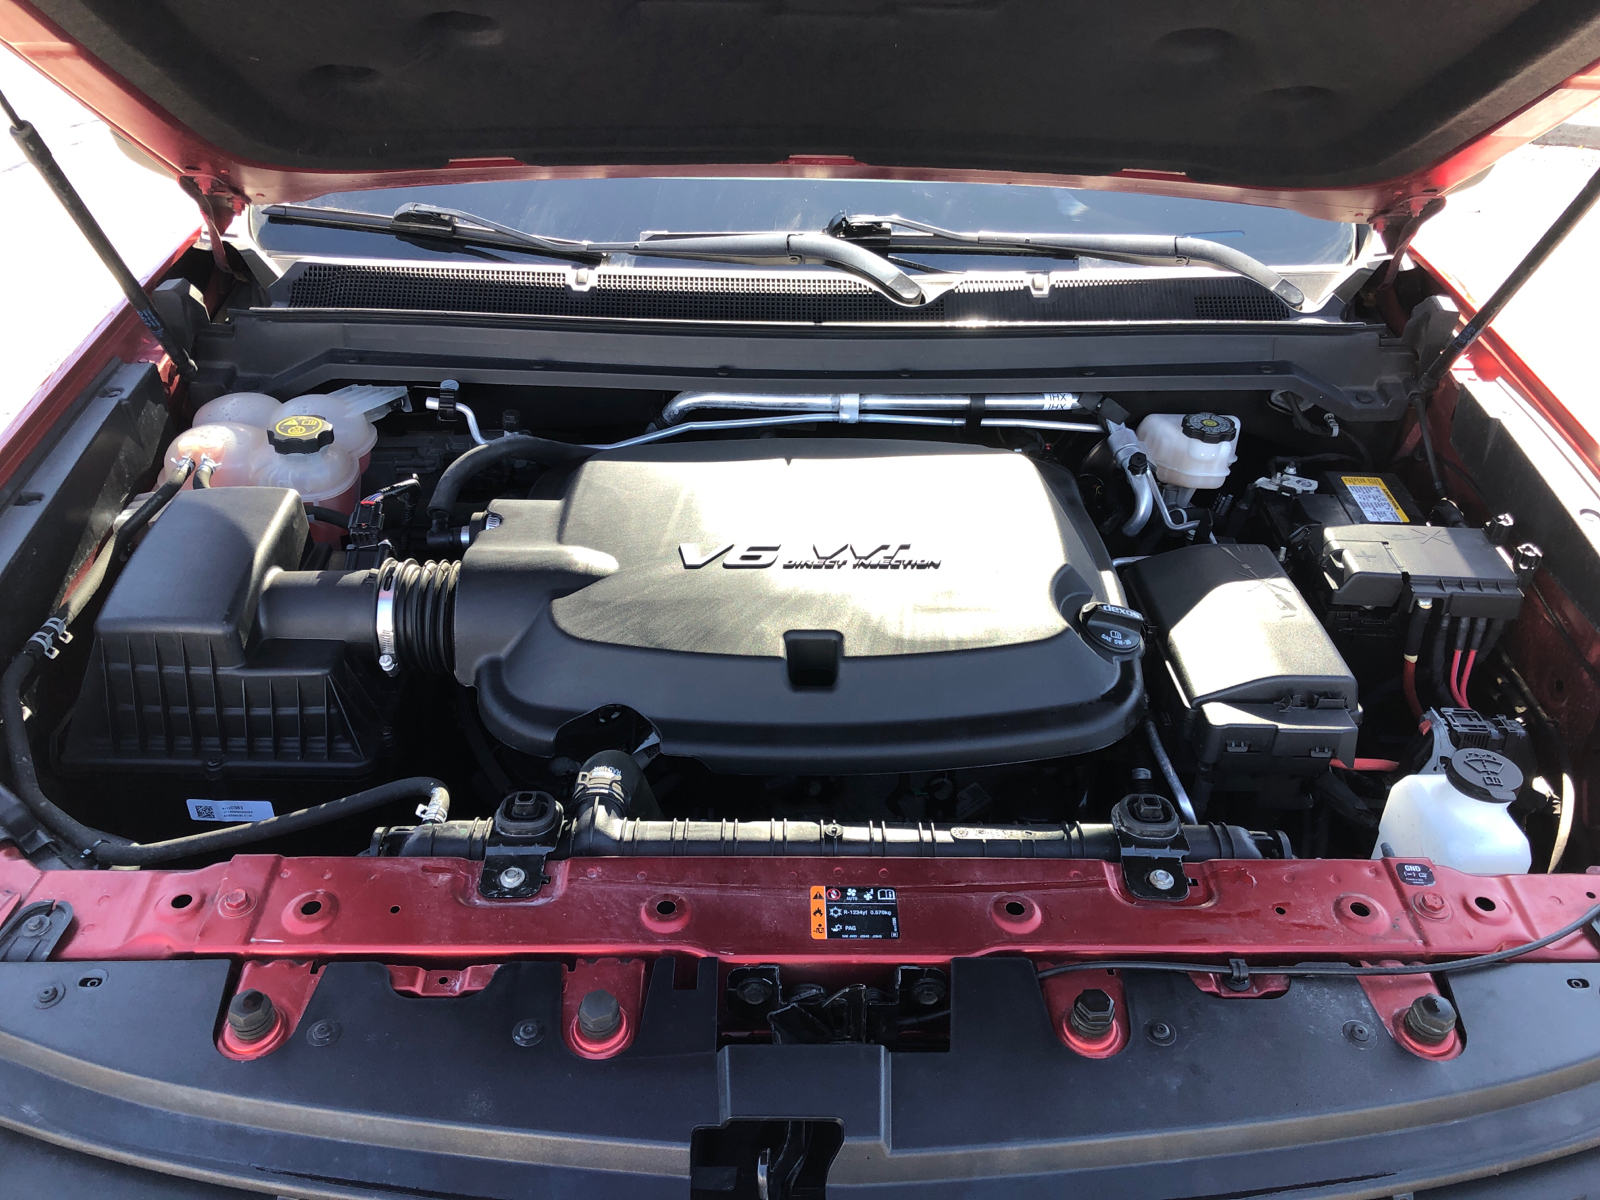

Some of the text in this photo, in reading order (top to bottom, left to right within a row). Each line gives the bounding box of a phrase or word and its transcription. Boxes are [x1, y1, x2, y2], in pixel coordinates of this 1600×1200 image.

[679, 544, 781, 569] V6
[782, 559, 942, 570] DIRECT INJECTION
[1102, 604, 1141, 619] dexos
